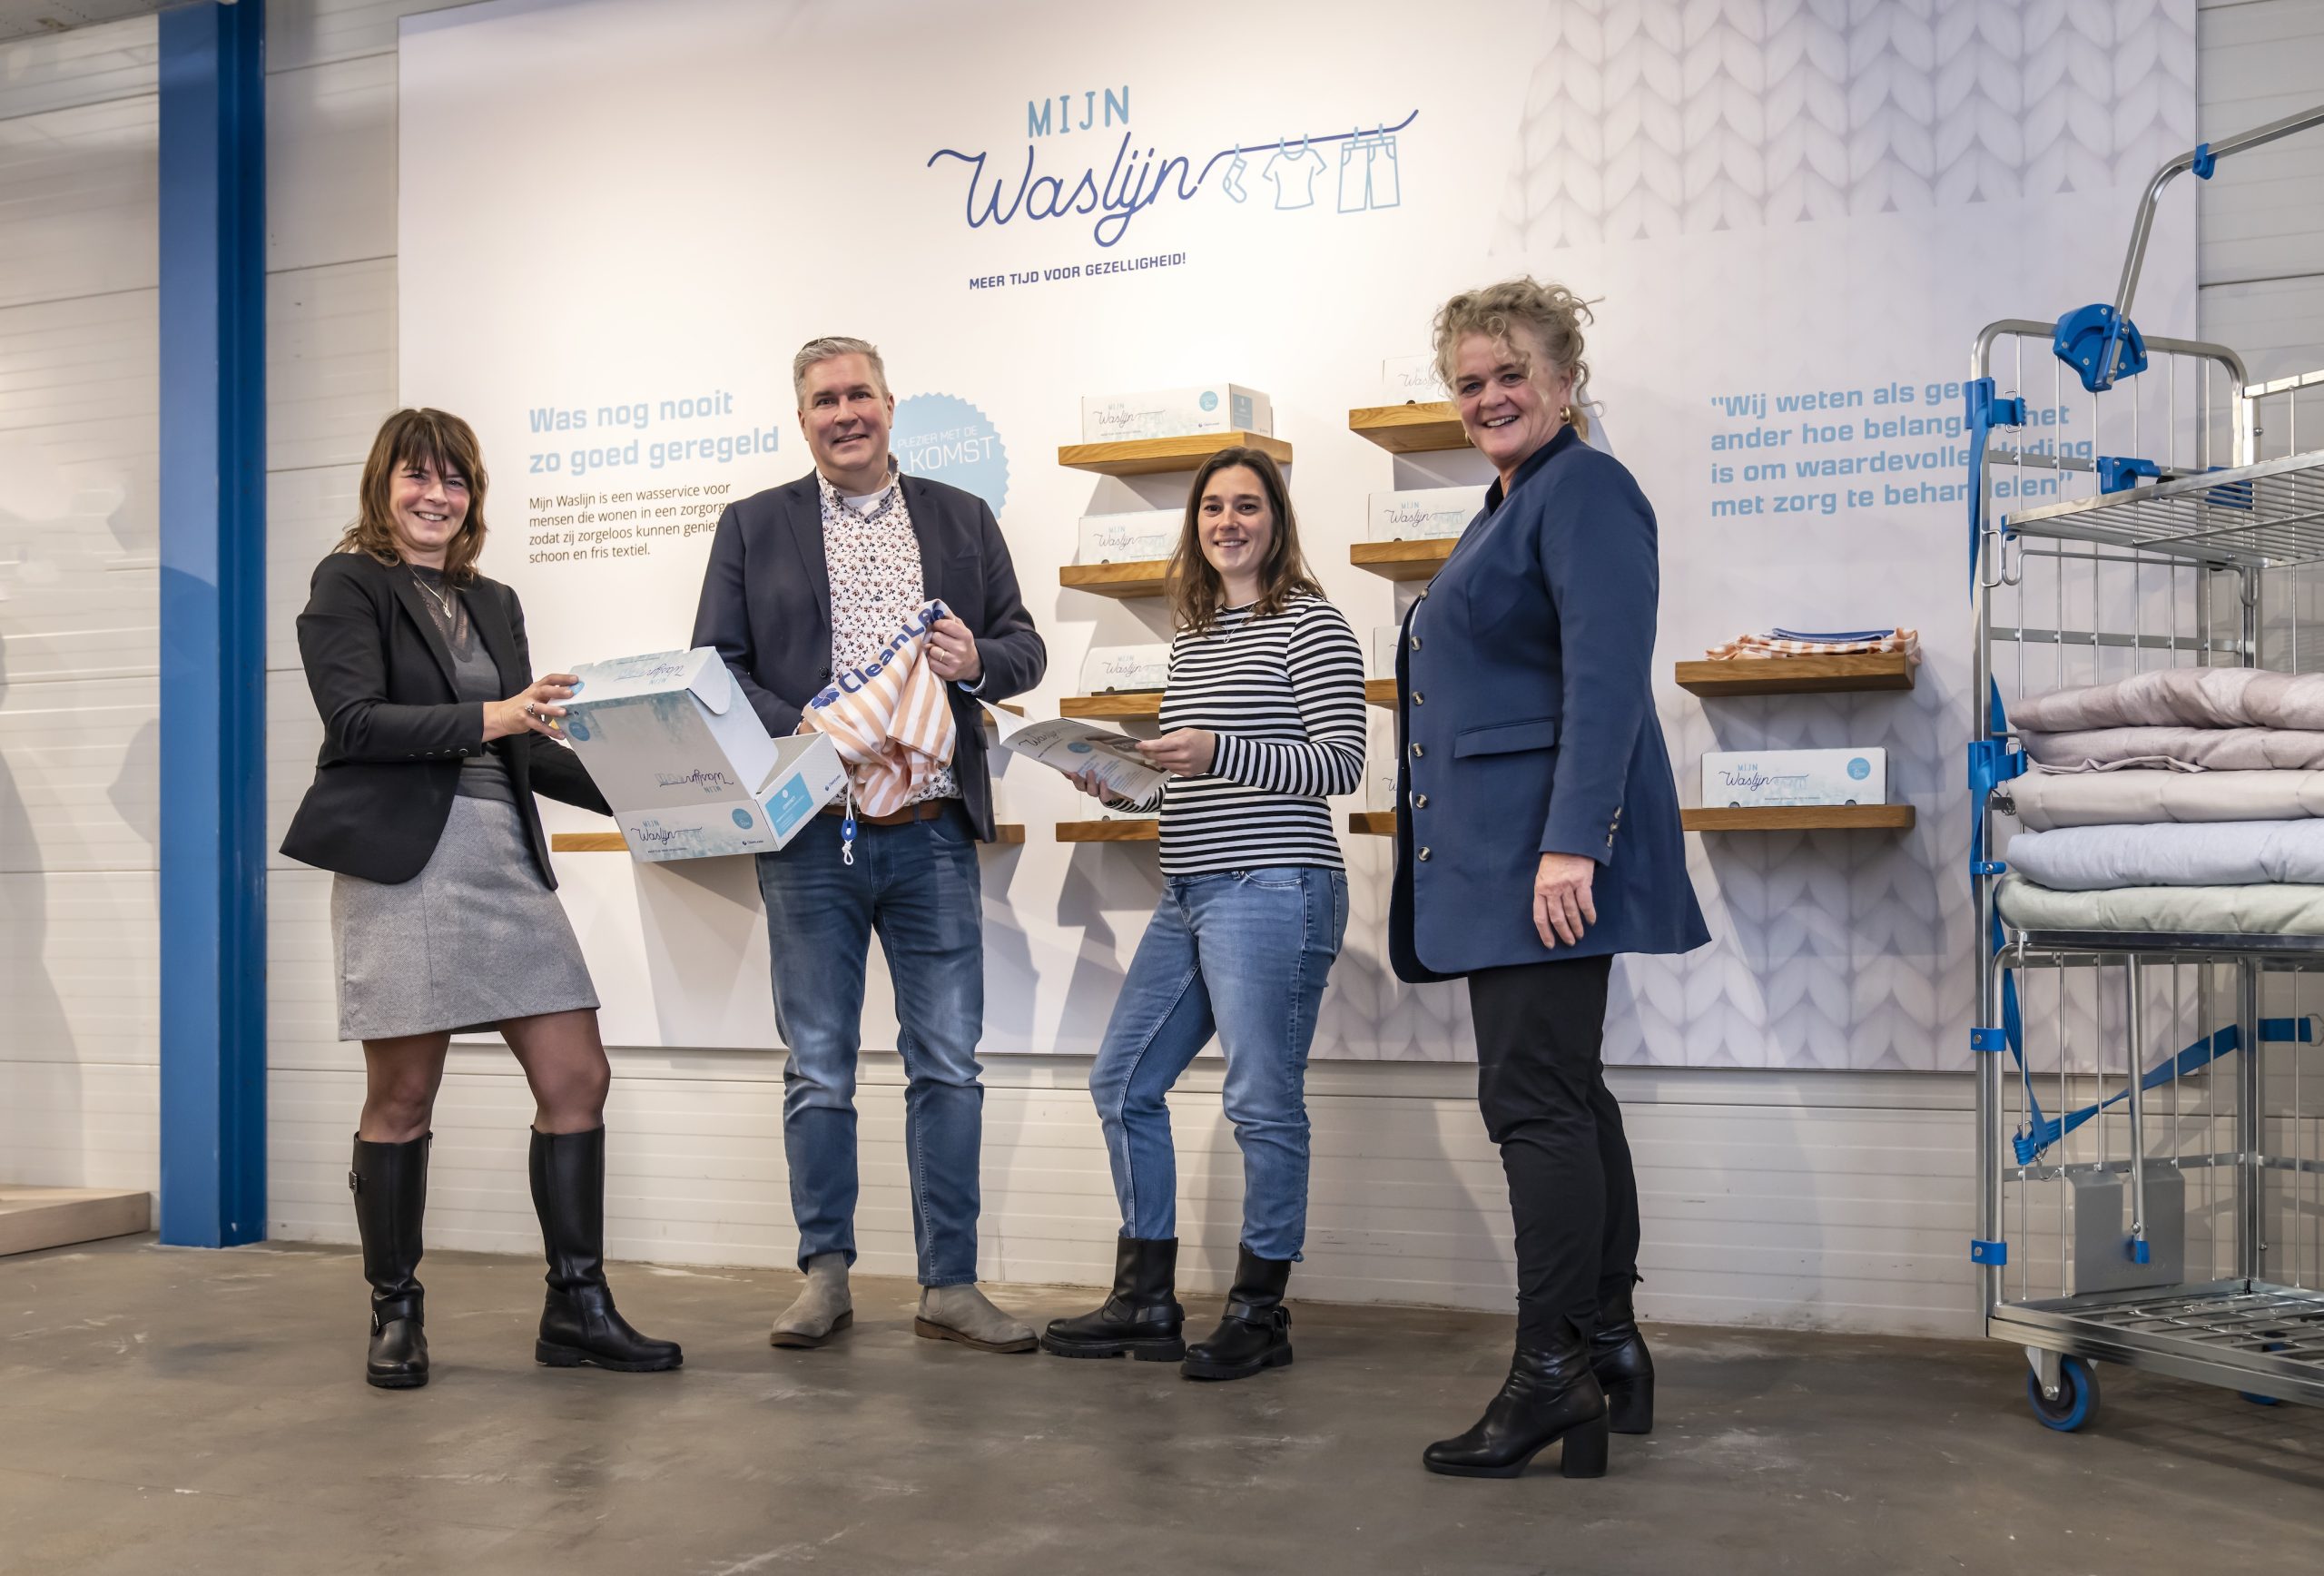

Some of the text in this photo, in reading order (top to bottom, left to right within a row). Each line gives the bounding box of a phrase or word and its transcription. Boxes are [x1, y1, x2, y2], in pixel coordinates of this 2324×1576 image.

[1028, 85, 1129, 138] MIJN
[928, 132, 1198, 247] Waslijn
[969, 251, 1187, 290] MEER TIJD VOOR GEZELLIGHEID!
[529, 389, 734, 433] Was nog nooit
[1777, 387, 1868, 413] weten
[1873, 381, 1915, 409] als
[940, 428, 960, 442] MET
[964, 425, 979, 438] DE
[1710, 427, 1792, 451] ander
[1802, 422, 1854, 444] hoe
[529, 426, 779, 477] zo goed geregeld
[901, 436, 995, 473] KOMST
[1710, 462, 1734, 484] is
[1743, 459, 1787, 481] om
[1796, 445, 1969, 478] waardevolle
[529, 482, 731, 512] Mijn Waslijn is een wasservice voor
[1710, 494, 1764, 517] met
[1773, 490, 1837, 515] zorg
[1847, 488, 1875, 509] te
[529, 502, 727, 527] mensen die wonen in een zorgorg
[529, 519, 718, 546] zodat zij zorgeloos kunnen genie
[529, 543, 651, 564] schoon en fris textiel.
[1718, 771, 1770, 792] Waslijn
[631, 827, 676, 845] Waslijn
